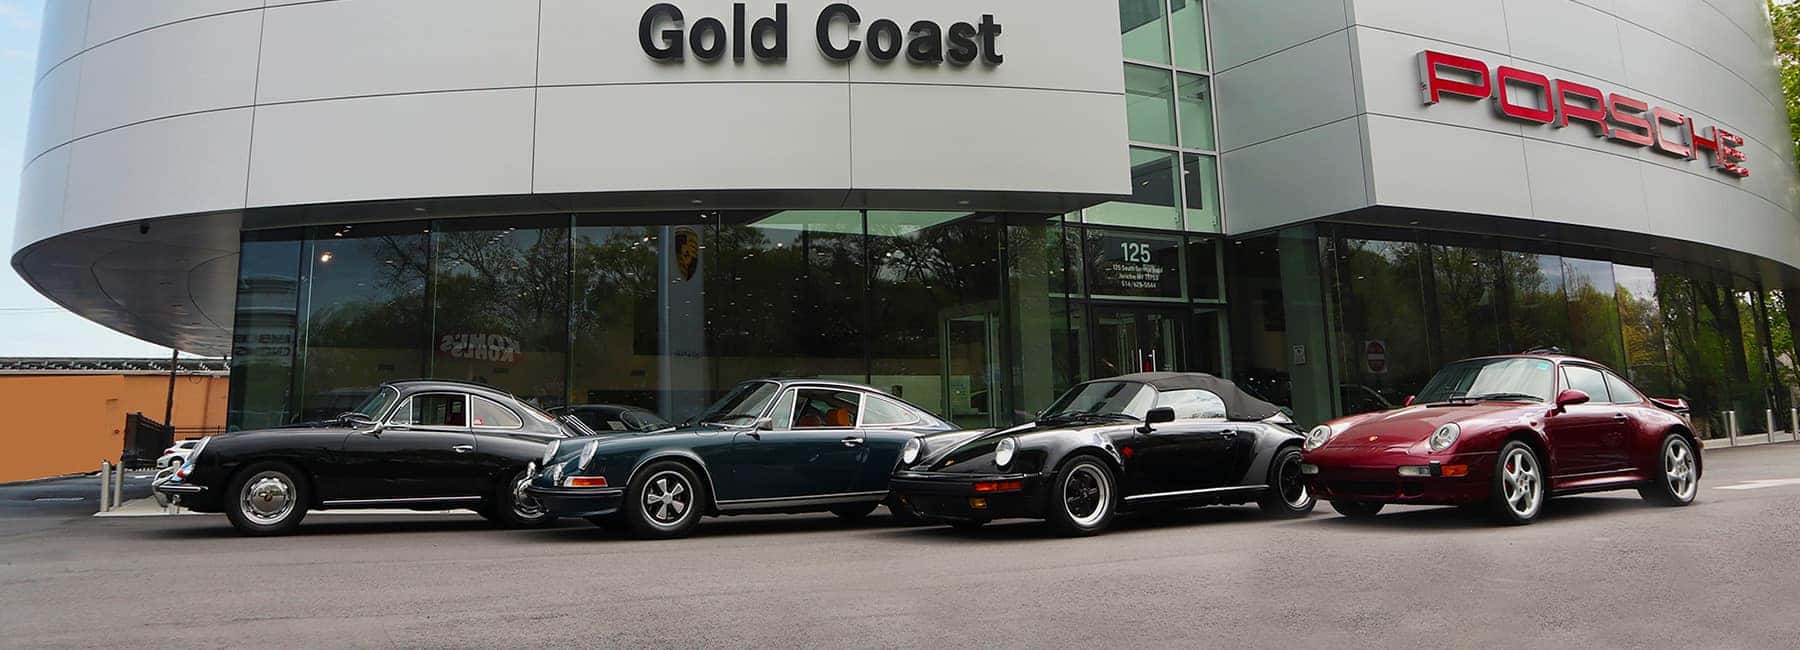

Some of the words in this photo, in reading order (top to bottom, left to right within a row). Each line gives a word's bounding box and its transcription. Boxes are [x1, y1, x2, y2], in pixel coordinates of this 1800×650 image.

[637, 2, 788, 64] Gold
[815, 2, 1004, 67] Coast
[1416, 49, 1750, 178] PORSCHE
[1120, 242, 1151, 263] 125
